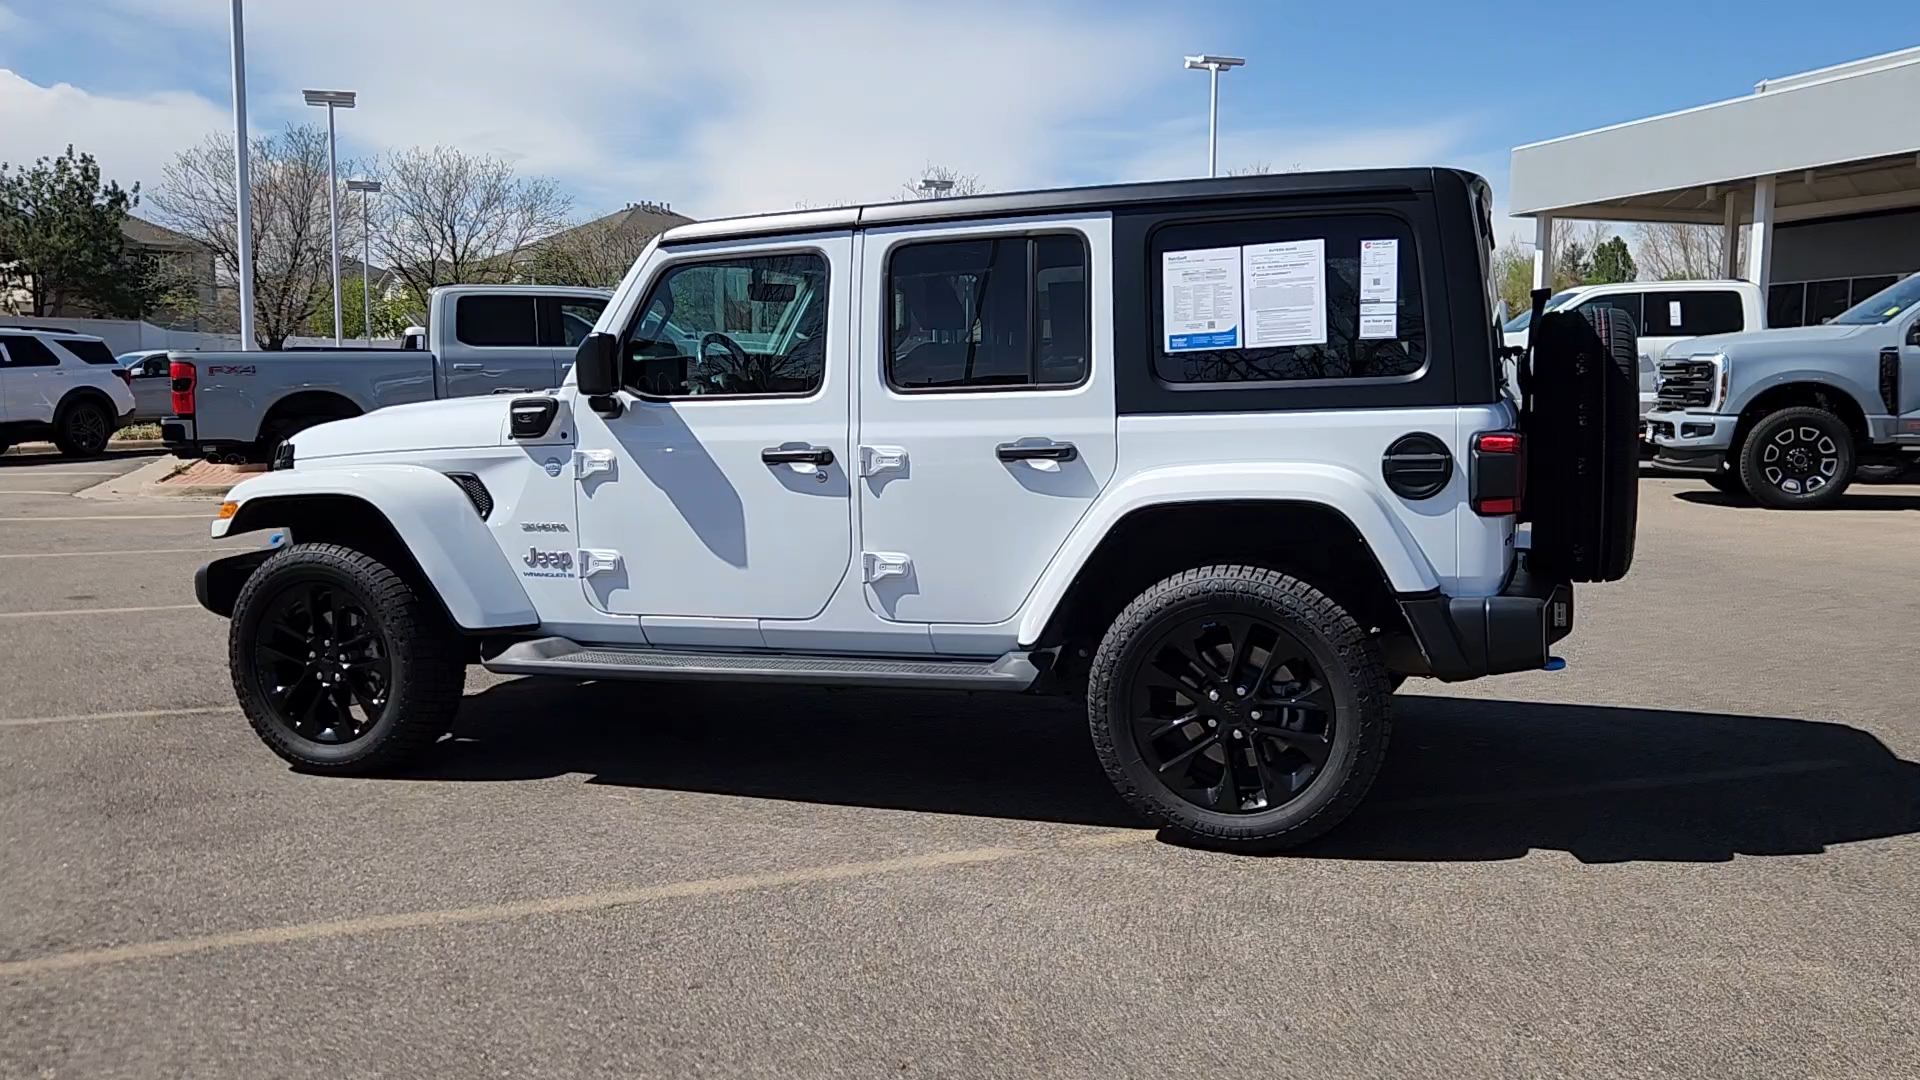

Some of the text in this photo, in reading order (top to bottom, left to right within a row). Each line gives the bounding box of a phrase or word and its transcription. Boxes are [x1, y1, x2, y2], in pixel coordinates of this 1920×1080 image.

[208, 365, 257, 376] FX4
[520, 522, 570, 533] SAHARA
[522, 545, 573, 571] Jeep
